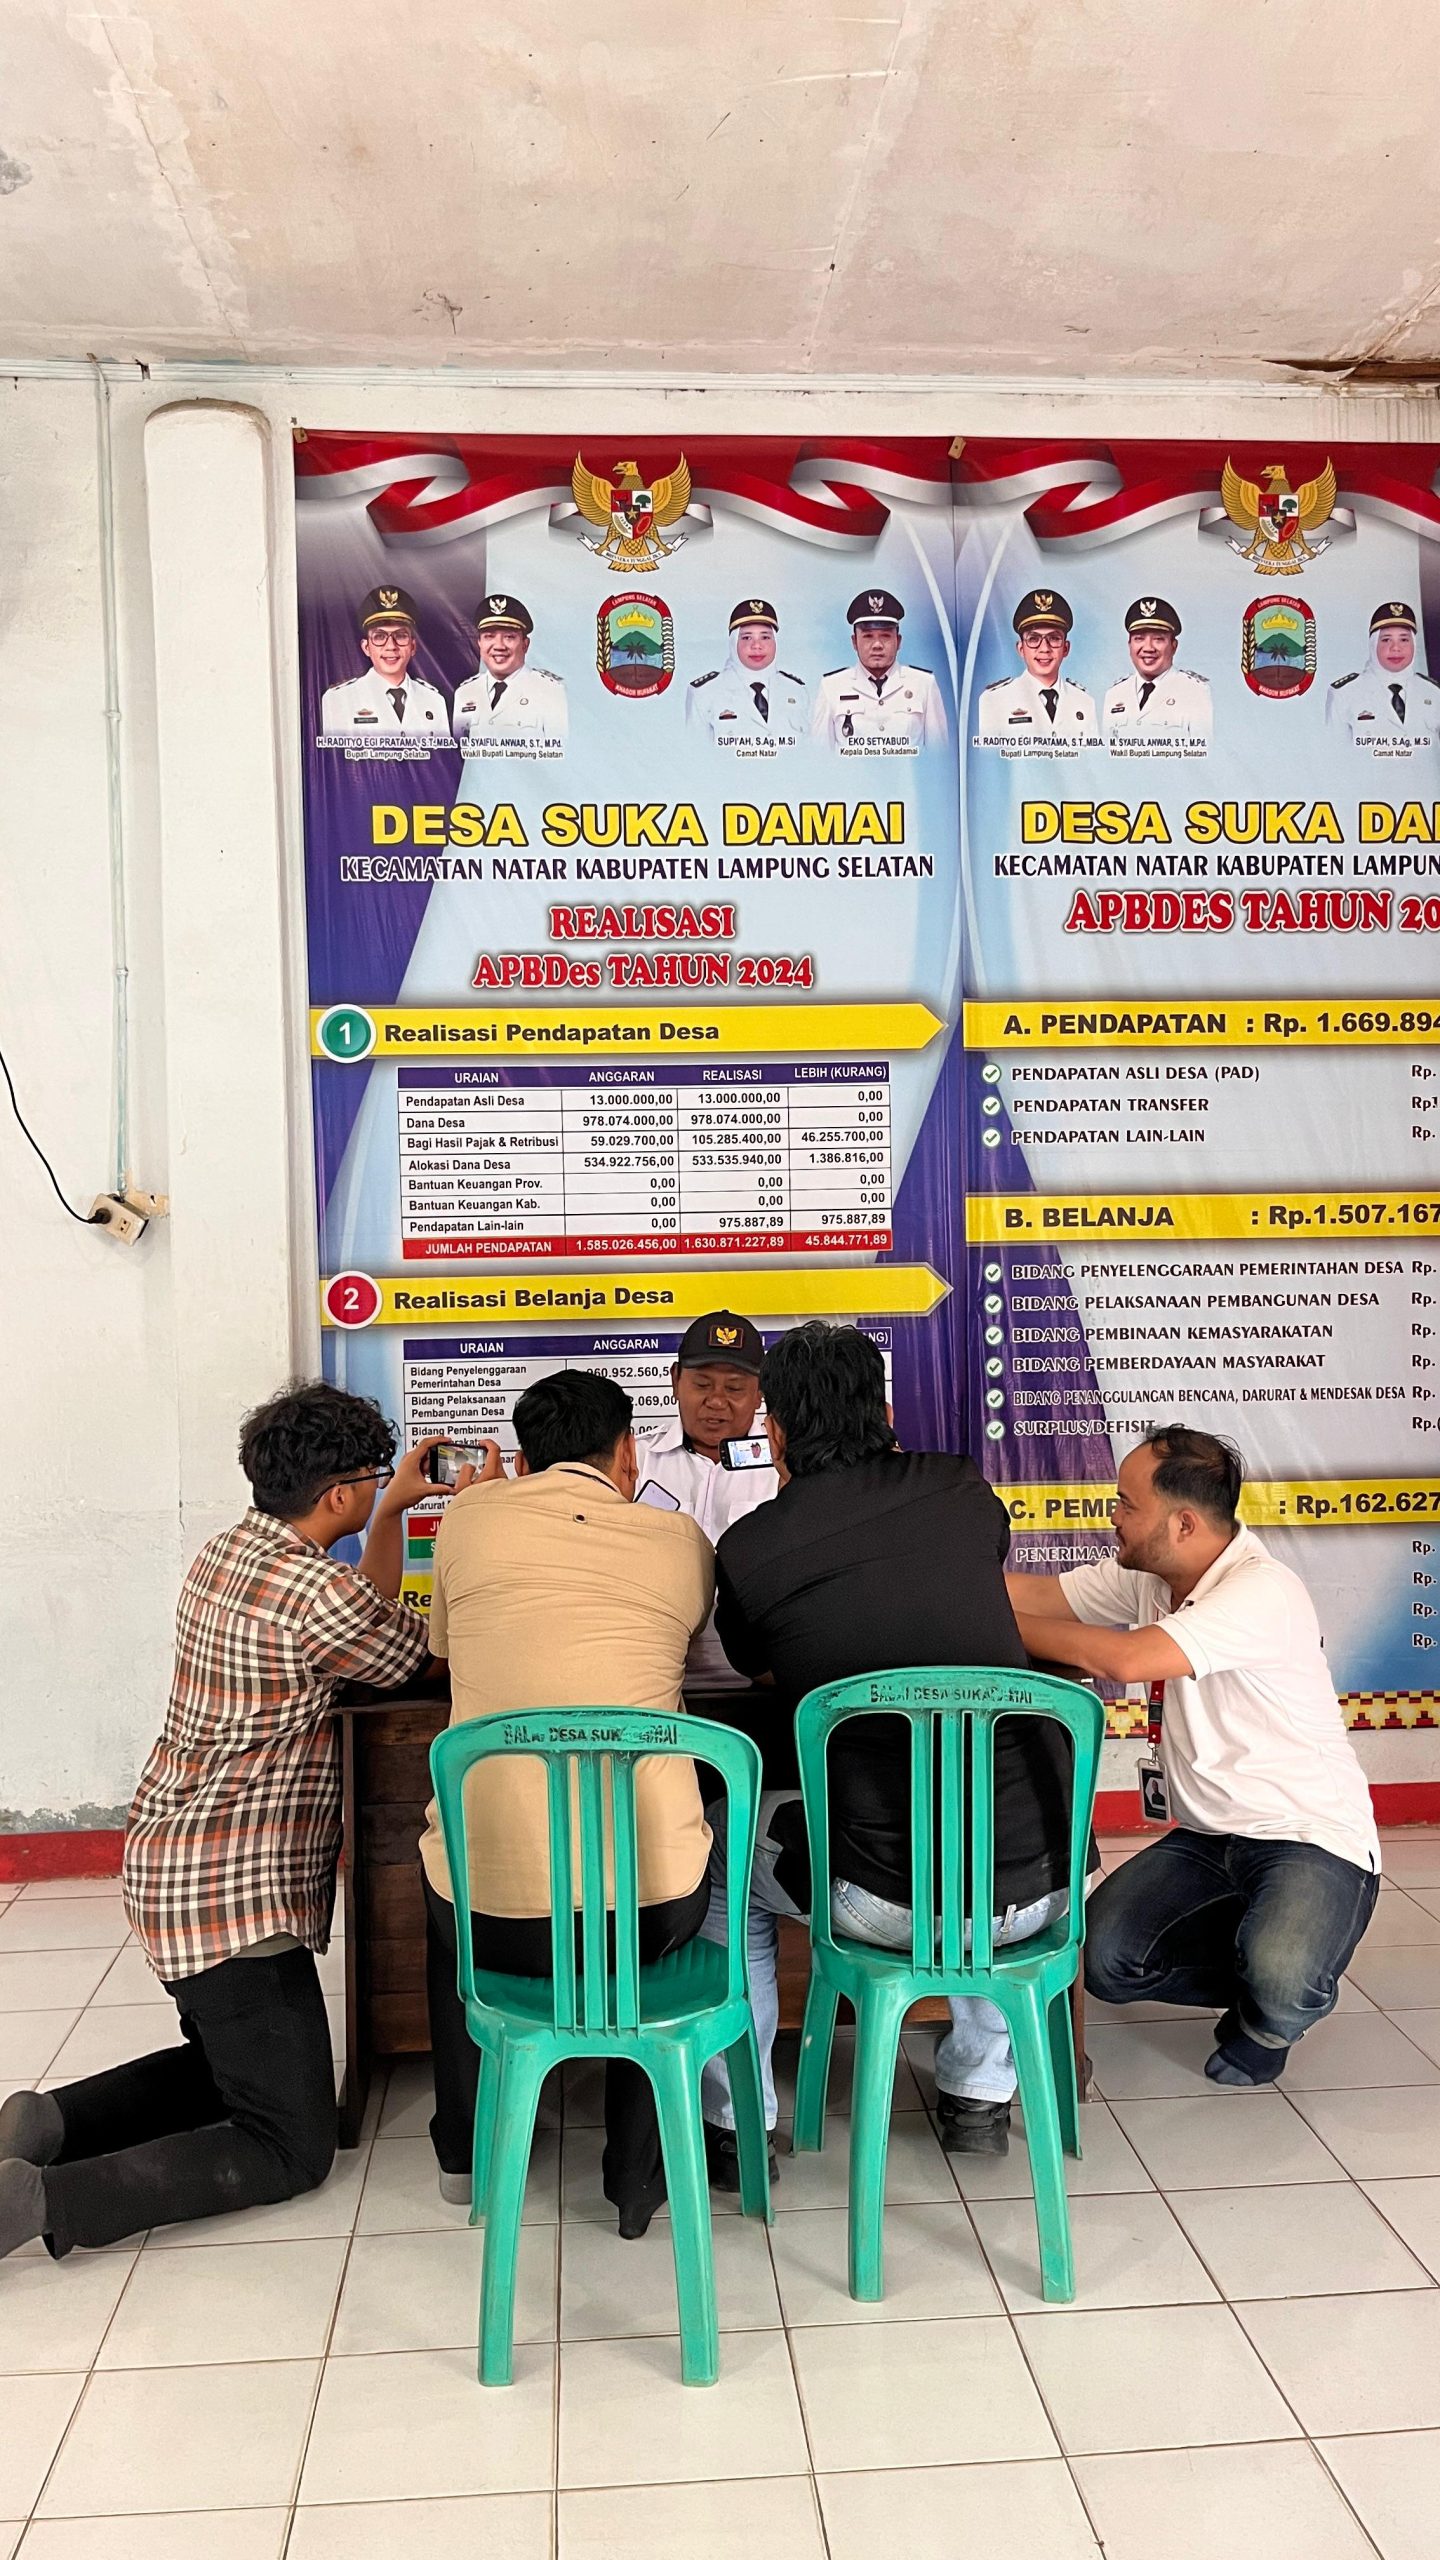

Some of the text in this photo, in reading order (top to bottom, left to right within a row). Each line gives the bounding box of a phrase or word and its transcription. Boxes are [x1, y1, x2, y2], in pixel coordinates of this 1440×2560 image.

[327, 738, 420, 747] RADITYO EGI PRATAMA,
[471, 738, 528, 748] SYAIFUL ANWAR,
[841, 748, 863, 756] Kepala
[347, 750, 402, 759] Bupati Lampung
[371, 801, 905, 847] DESA SUKA DAMAI
[1021, 801, 1440, 844] DESA SUKA DA
[341, 854, 934, 882] KECAMATAN NATAR KABUPATEN LAMPUNG SELATAN
[995, 855, 1127, 876] KECAMATAN
[1137, 855, 1208, 875] NATAR
[1217, 855, 1344, 875] KABUPATEN
[1065, 890, 1234, 933] APBDES
[1240, 889, 1392, 932] TAHUN
[549, 905, 735, 940] REALISASI
[473, 954, 813, 988] APBDes TAHUN 2024
[339, 1022, 352, 1046] 1
[385, 1021, 719, 1044] Realisasi Pendapatan Desa
[1004, 1014, 1306, 1037] A. PENDAPATAN Rp.
[455, 1066, 887, 1083] URAIAN ANGGARAN REALISASI LEBIH (KURANG)
[1012, 1066, 1260, 1082] PENDAPATAN ASLI DESA (PAD)
[406, 1090, 883, 1109] Pendapatan Asli Desa 13.000.000,00 13.000.000,00 0,00
[1013, 1098, 1209, 1113] PENDAPATAN TRANSFER
[407, 1110, 884, 1129] Dana Desa 978.074.000,00 978.074.000,00 0,00
[407, 1130, 884, 1150] Bagi Hasil Pajak & Retribusi 59.029.700,00 105.285.400,00 46.255.700,00
[1012, 1128, 1205, 1145] PENDAPATAN LAIN-LAIN
[408, 1150, 884, 1170] Alokasi Dana Desa 534.922.756,00 533.535.940,00 1.386.816,00
[409, 1172, 885, 1192] Bantuan Keuangan Prov. 0,00 0,00 0,00
[409, 1191, 885, 1212] Bantuan Keuangan Kab. 0,00 0,00 0,00
[410, 1212, 886, 1234] Pendapatan Lain-lain 0,00 975.887,89 975.887,89
[1006, 1208, 1032, 1228] B.
[1043, 1207, 1174, 1227] BELANJA
[426, 1233, 887, 1254] JUMLAH PENDAPATAN 1.585.026.456,00 1.630.871.227,89 45.844.771,89
[1012, 1261, 1403, 1280] BIDANG PENYELENGGARAAN PEMERINTAHAN DESA
[344, 1289, 359, 1310] 2
[394, 1288, 674, 1310] Realisasi Belanja Desa
[1012, 1292, 1379, 1312] BIDANG PELAKSANAAN PEMBANGUNAN DESA
[1013, 1324, 1333, 1343] BIDANG PEMBINAAN KEMASYARAKATAN
[460, 1342, 503, 1353] URAIAN
[593, 1338, 658, 1350] ANGGARAN
[411, 1365, 526, 1377] Bidang Penyelenggaraan
[1013, 1355, 1326, 1372] BIDANG PEMBERDAYAAN MASYARAKAT
[411, 1378, 501, 1388] Pemerintahan Desa
[412, 1395, 506, 1406] Bidang Pelaksanaan
[1013, 1386, 1406, 1406] BIDANG PENANGGULANGAN BENCANA, DARURAT & MENDESAK DESA
[412, 1407, 504, 1418] Pembangunan Desa
[412, 1425, 499, 1436] Bidang Pembinaan
[1010, 1499, 1035, 1519] C.
[914, 1688, 949, 1700] DESA
[549, 1728, 587, 1742] DESA
